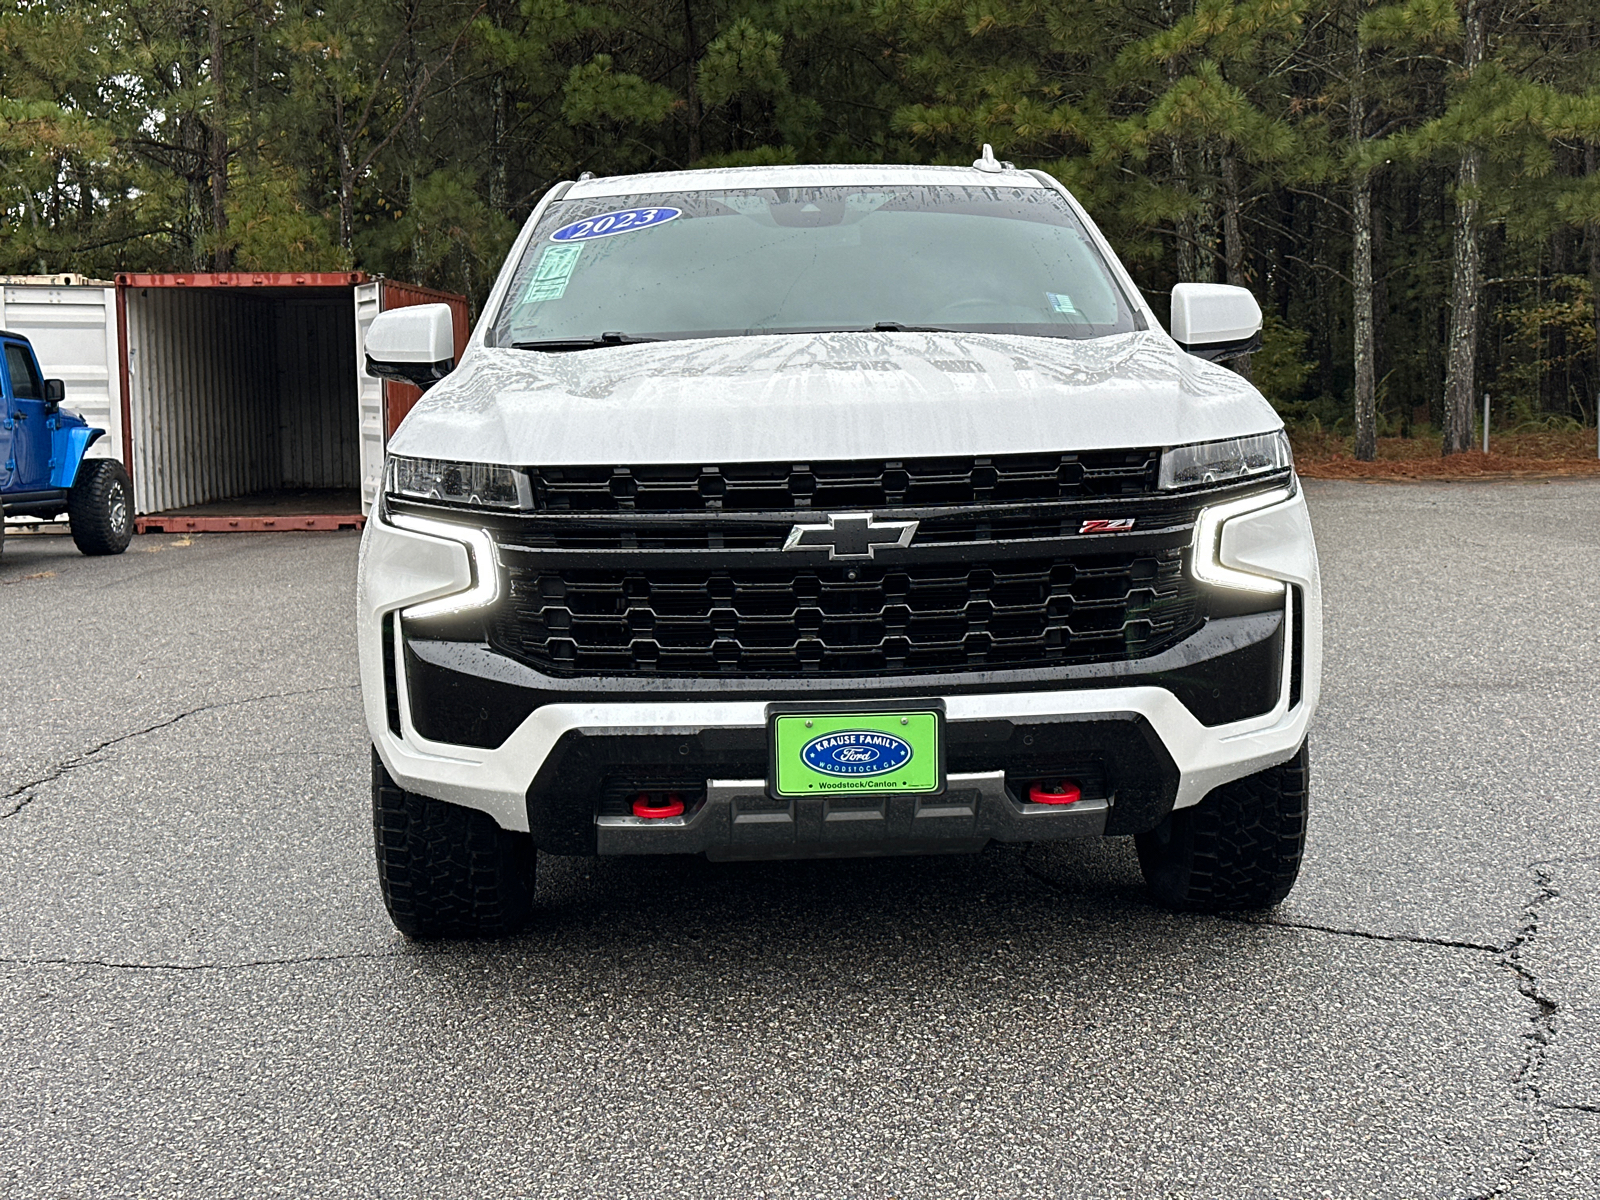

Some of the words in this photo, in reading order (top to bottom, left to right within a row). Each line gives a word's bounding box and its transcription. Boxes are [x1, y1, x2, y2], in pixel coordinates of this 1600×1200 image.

[569, 209, 658, 239] 2023
[816, 736, 856, 751] KRAUSE
[859, 736, 898, 749] FAMILY
[840, 748, 872, 761] Ford
[883, 759, 896, 768] GA
[818, 781, 897, 789] Woodstock/Canton
